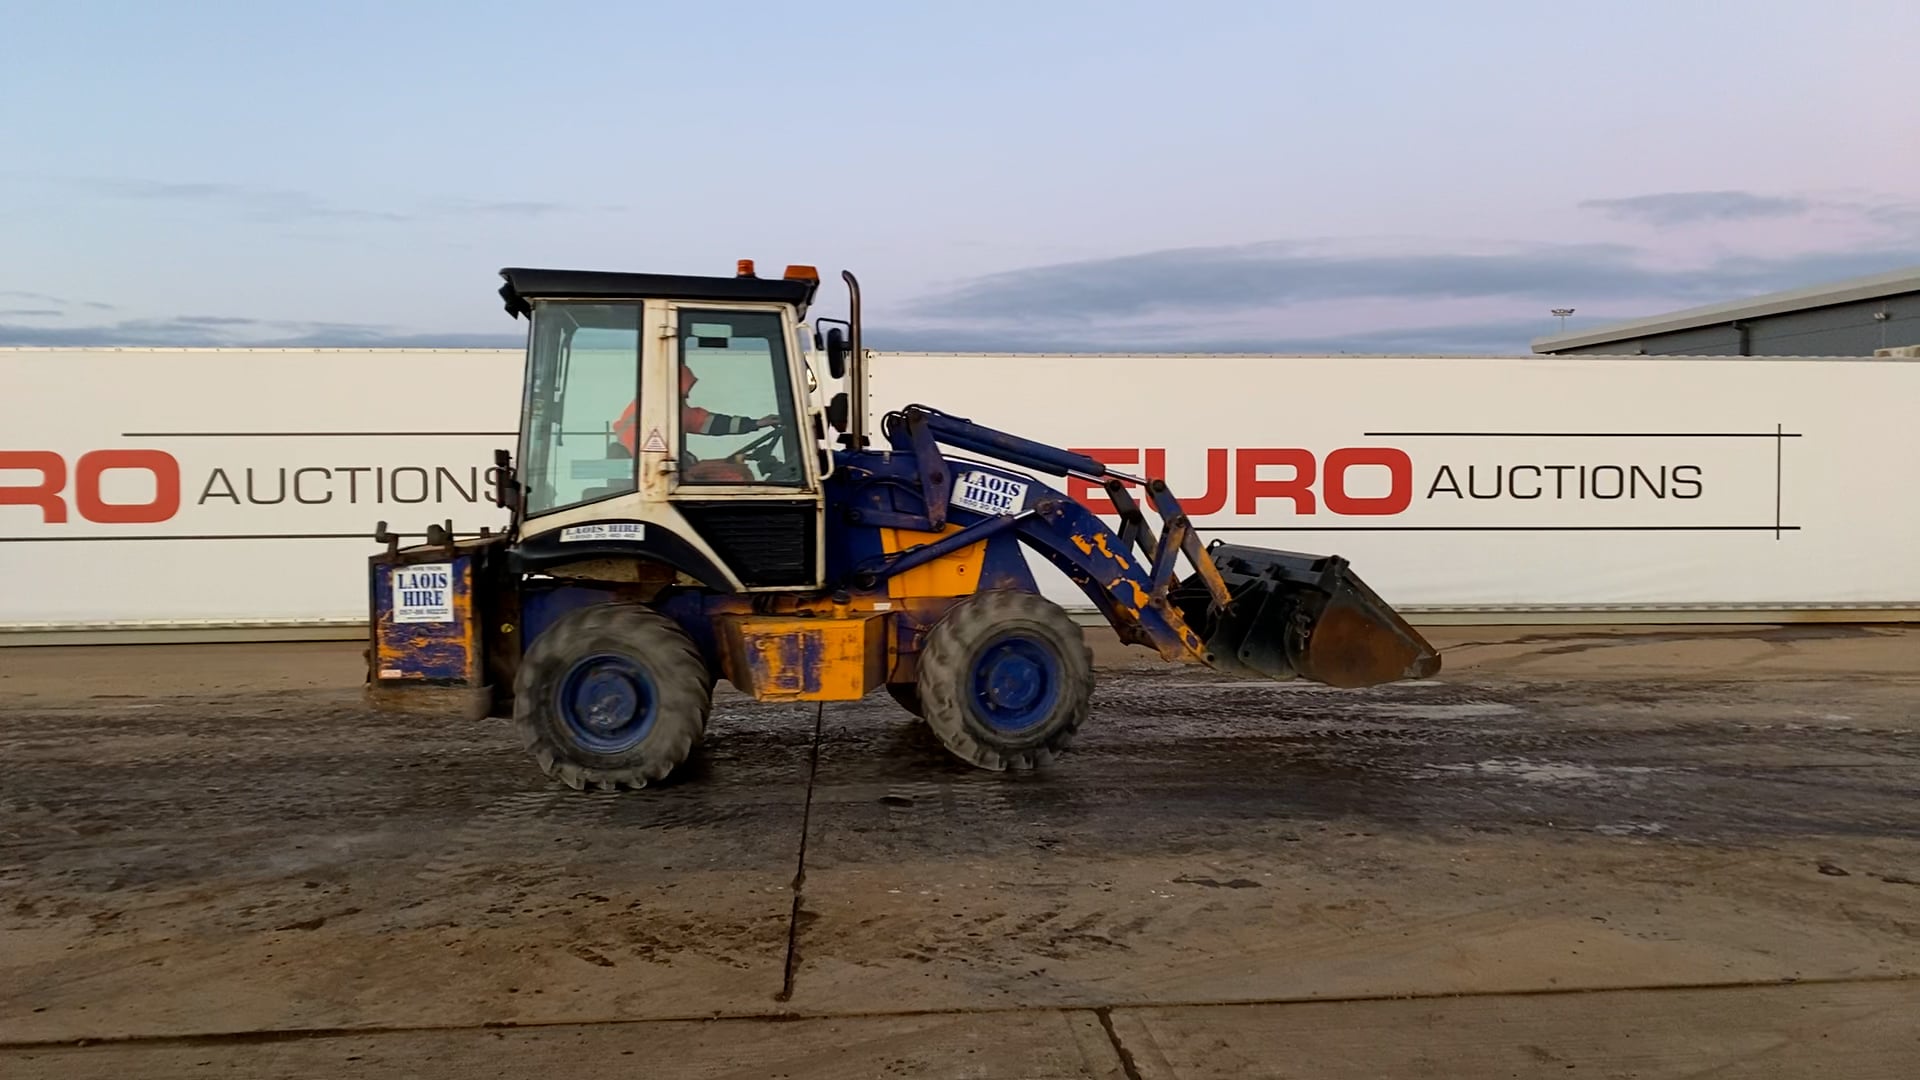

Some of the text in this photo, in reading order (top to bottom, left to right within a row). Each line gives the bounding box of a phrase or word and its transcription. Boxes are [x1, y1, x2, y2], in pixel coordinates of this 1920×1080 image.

[962, 472, 1021, 497] LAOIS
[1066, 448, 1703, 516] EURO AUCTIONS
[964, 486, 1013, 510] HIRE
[566, 524, 641, 536] LAOIS HIRE
[397, 572, 449, 590] LAOIS
[403, 590, 445, 607] HIRE
